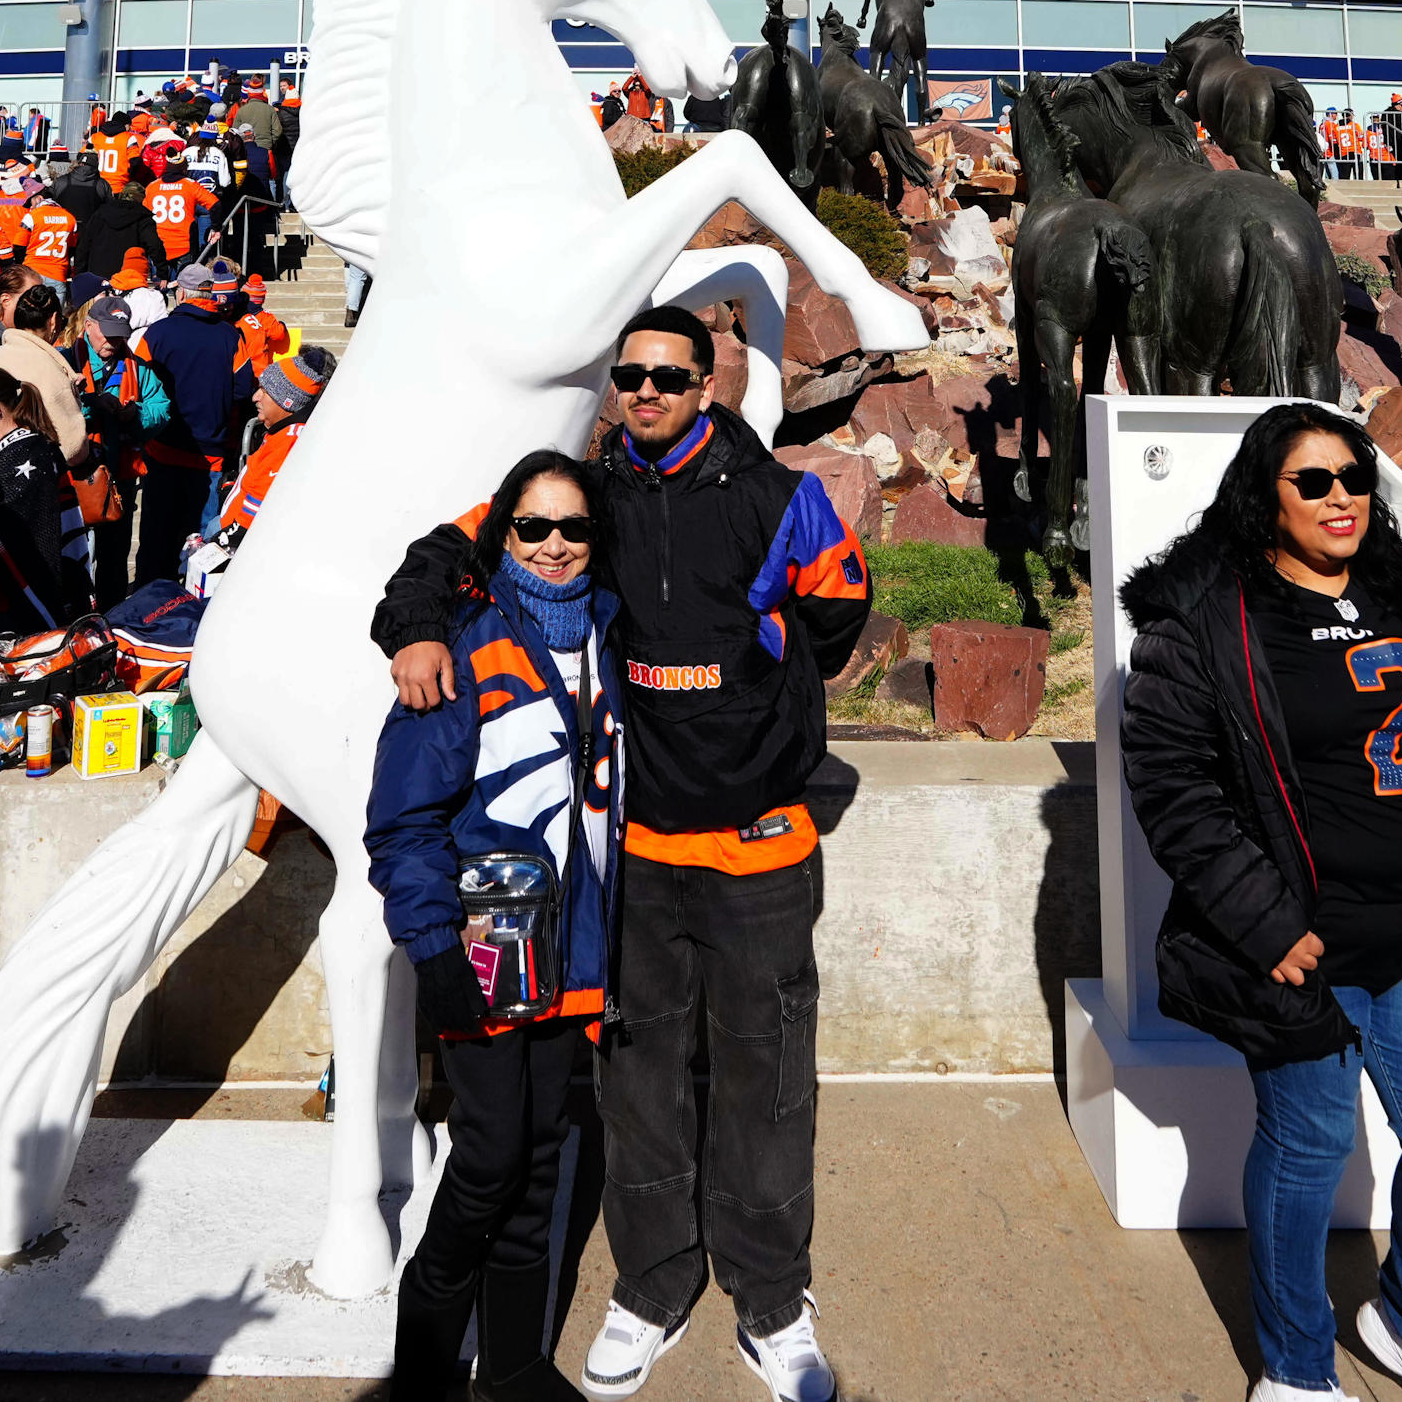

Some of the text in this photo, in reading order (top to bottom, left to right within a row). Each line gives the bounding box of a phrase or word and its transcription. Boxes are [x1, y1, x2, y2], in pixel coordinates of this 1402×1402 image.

[159, 183, 183, 191] THOMAS
[152, 195, 186, 223] 88
[35, 231, 69, 258] 23
[626, 660, 722, 691] BRONCOS
